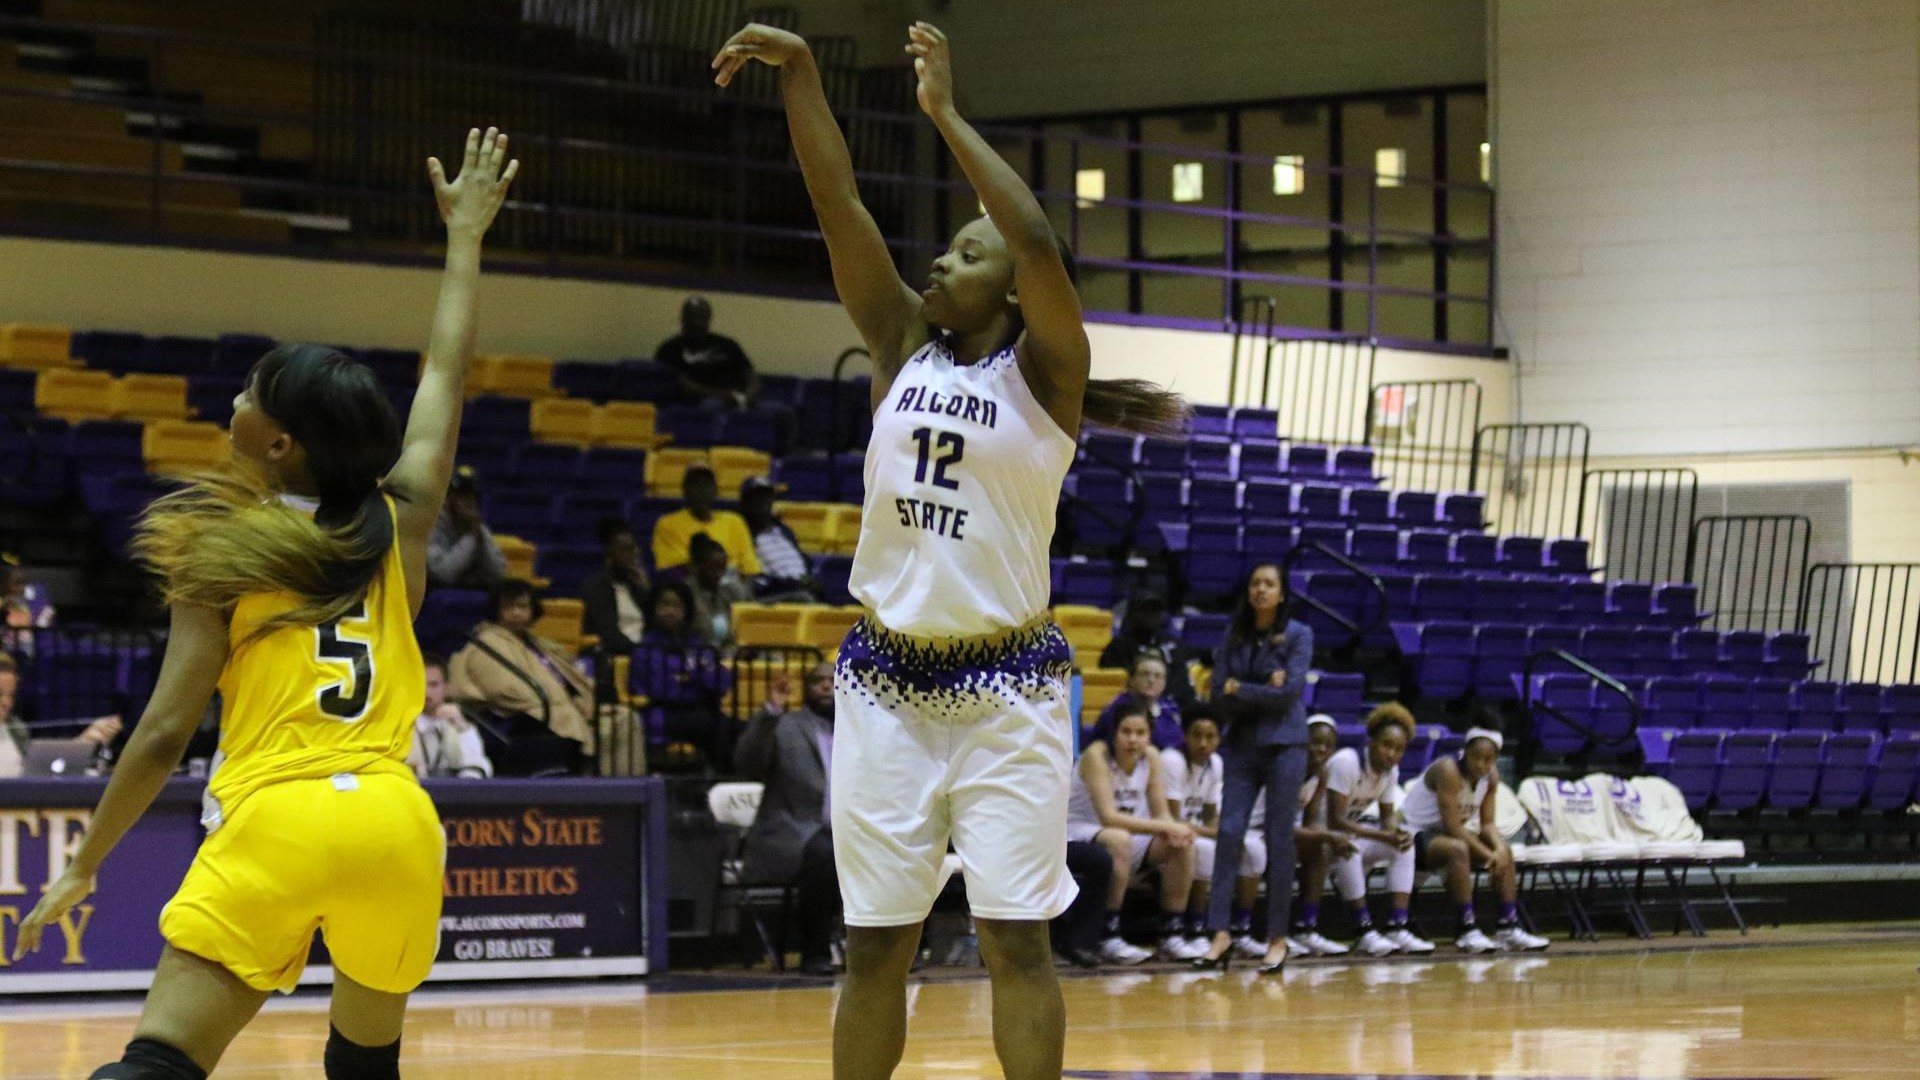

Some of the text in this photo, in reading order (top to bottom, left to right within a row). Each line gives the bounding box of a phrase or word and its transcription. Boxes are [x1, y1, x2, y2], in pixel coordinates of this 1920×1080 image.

[895, 385, 998, 429] ALCORN
[912, 427, 965, 491] 12
[895, 498, 969, 541] STATE
[315, 598, 375, 723] 5
[454, 938, 484, 960] GO
